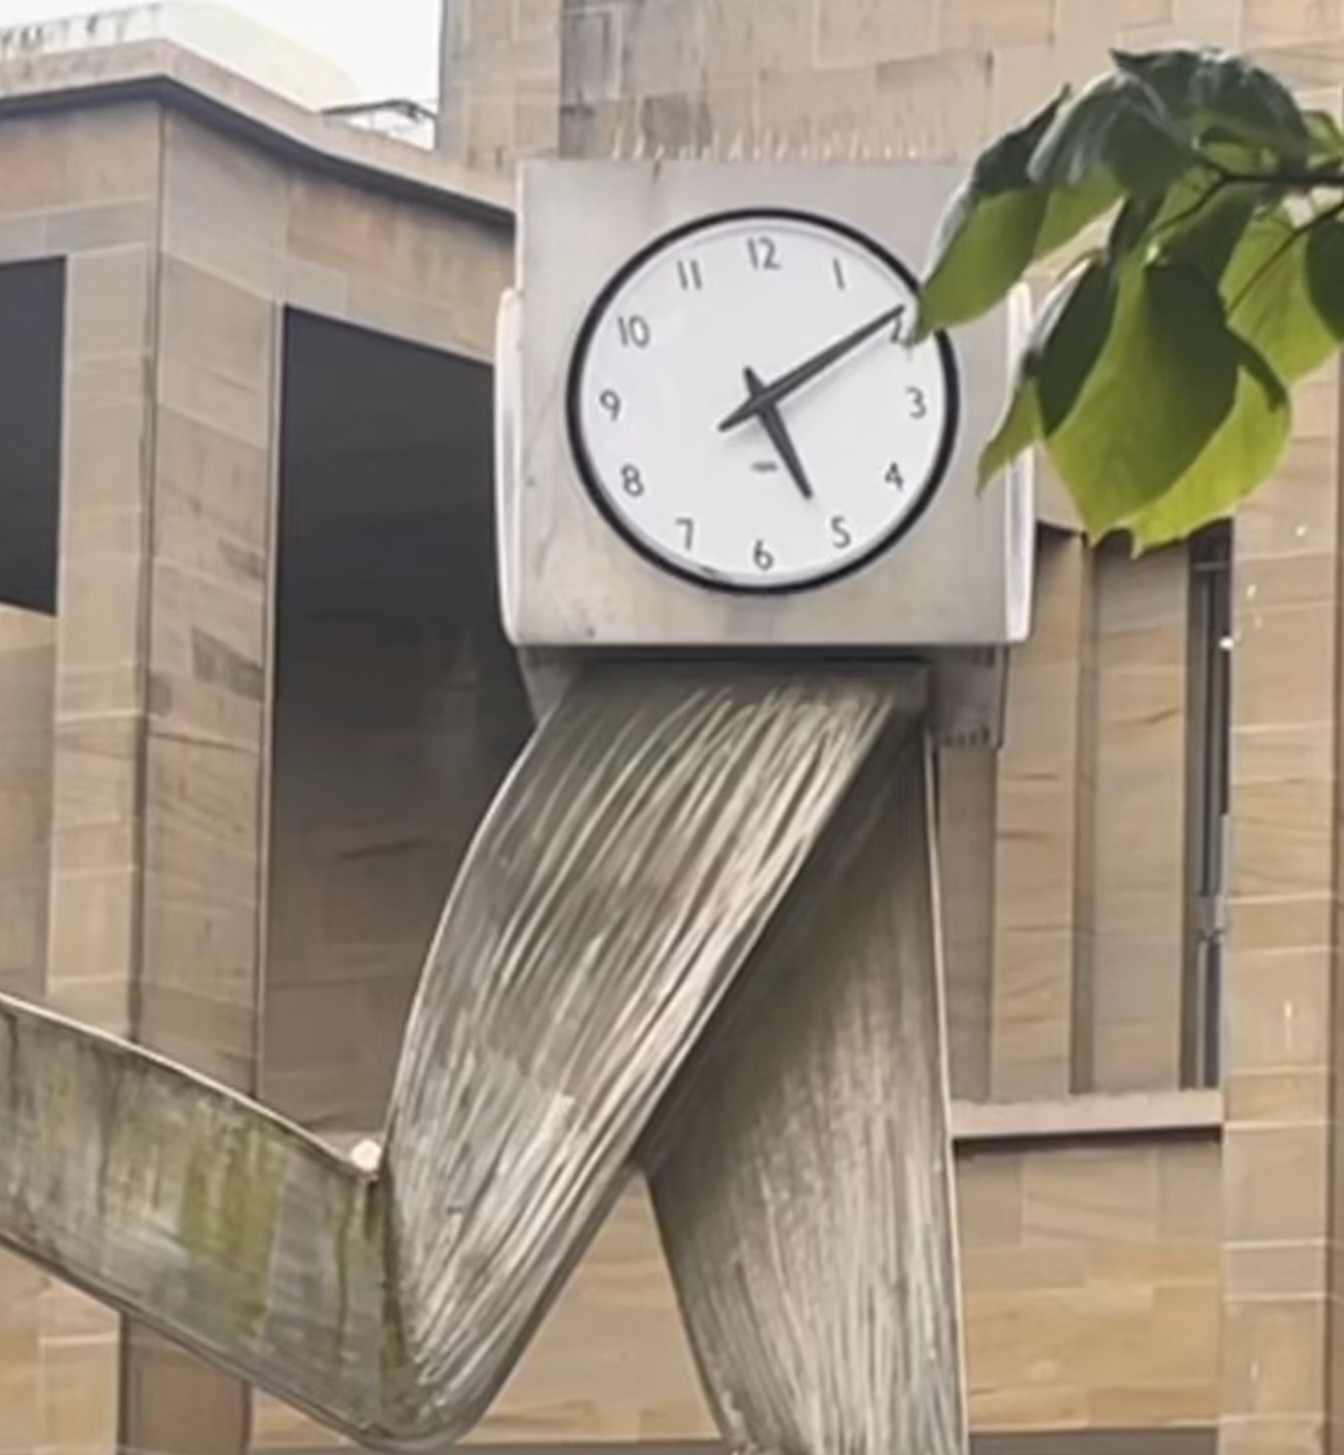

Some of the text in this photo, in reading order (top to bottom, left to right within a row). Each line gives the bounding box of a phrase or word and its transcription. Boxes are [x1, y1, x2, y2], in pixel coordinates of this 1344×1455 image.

[747, 237, 780, 270] 12
[677, 260, 702, 291] 11
[833, 258, 845, 290] 1
[617, 314, 650, 349] 10
[599, 389, 622, 421] 9
[905, 386, 927, 419] 3
[621, 464, 645, 497] 8
[884, 461, 905, 491] 4
[675, 517, 695, 550] 7
[830, 516, 851, 549] 5
[754, 540, 774, 571] 6
